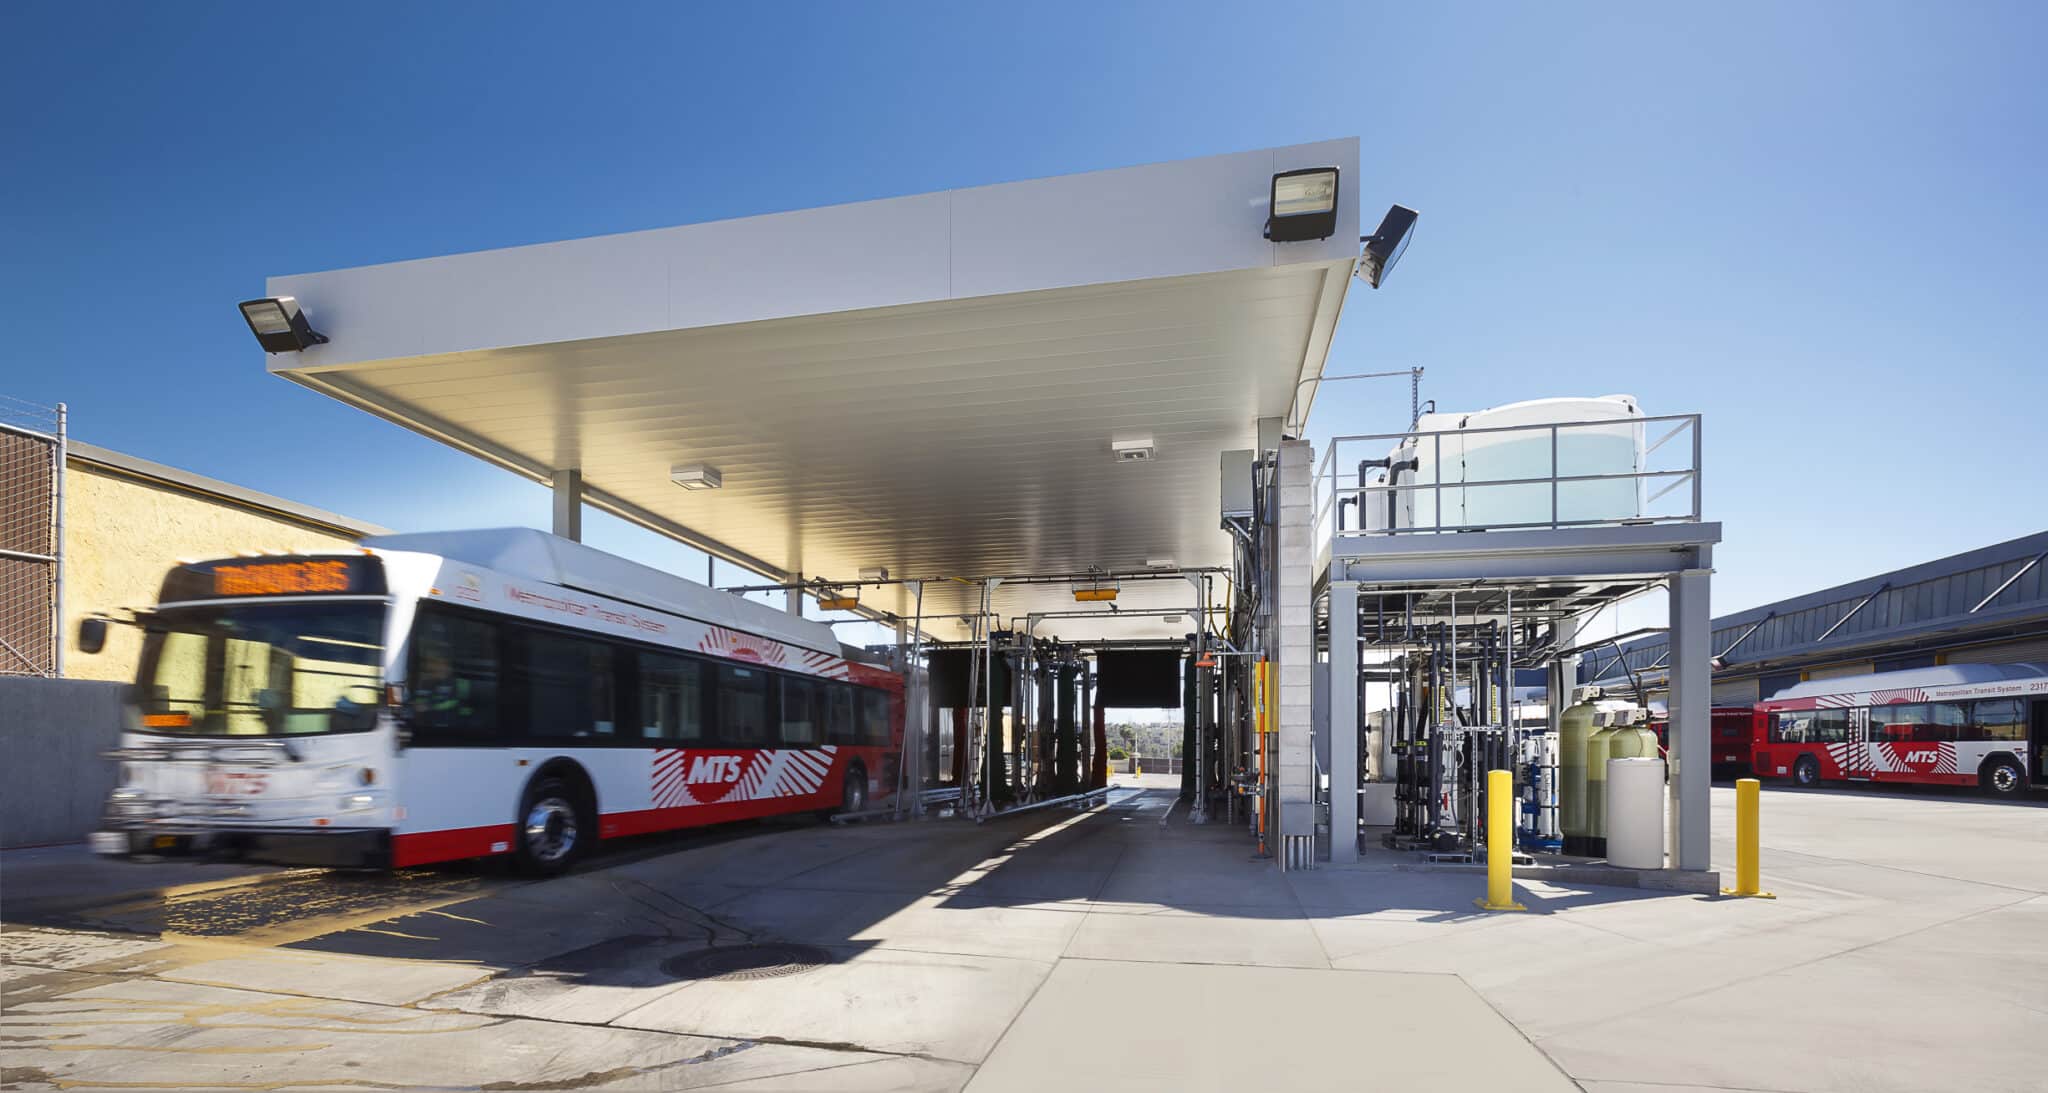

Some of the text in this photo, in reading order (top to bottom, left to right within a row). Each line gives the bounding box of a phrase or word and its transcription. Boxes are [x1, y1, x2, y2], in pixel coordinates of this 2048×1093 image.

[1974, 687, 1995, 695] Transit
[1997, 685, 2022, 694] System
[1904, 751, 1937, 763] MTS
[687, 756, 742, 784] MTS
